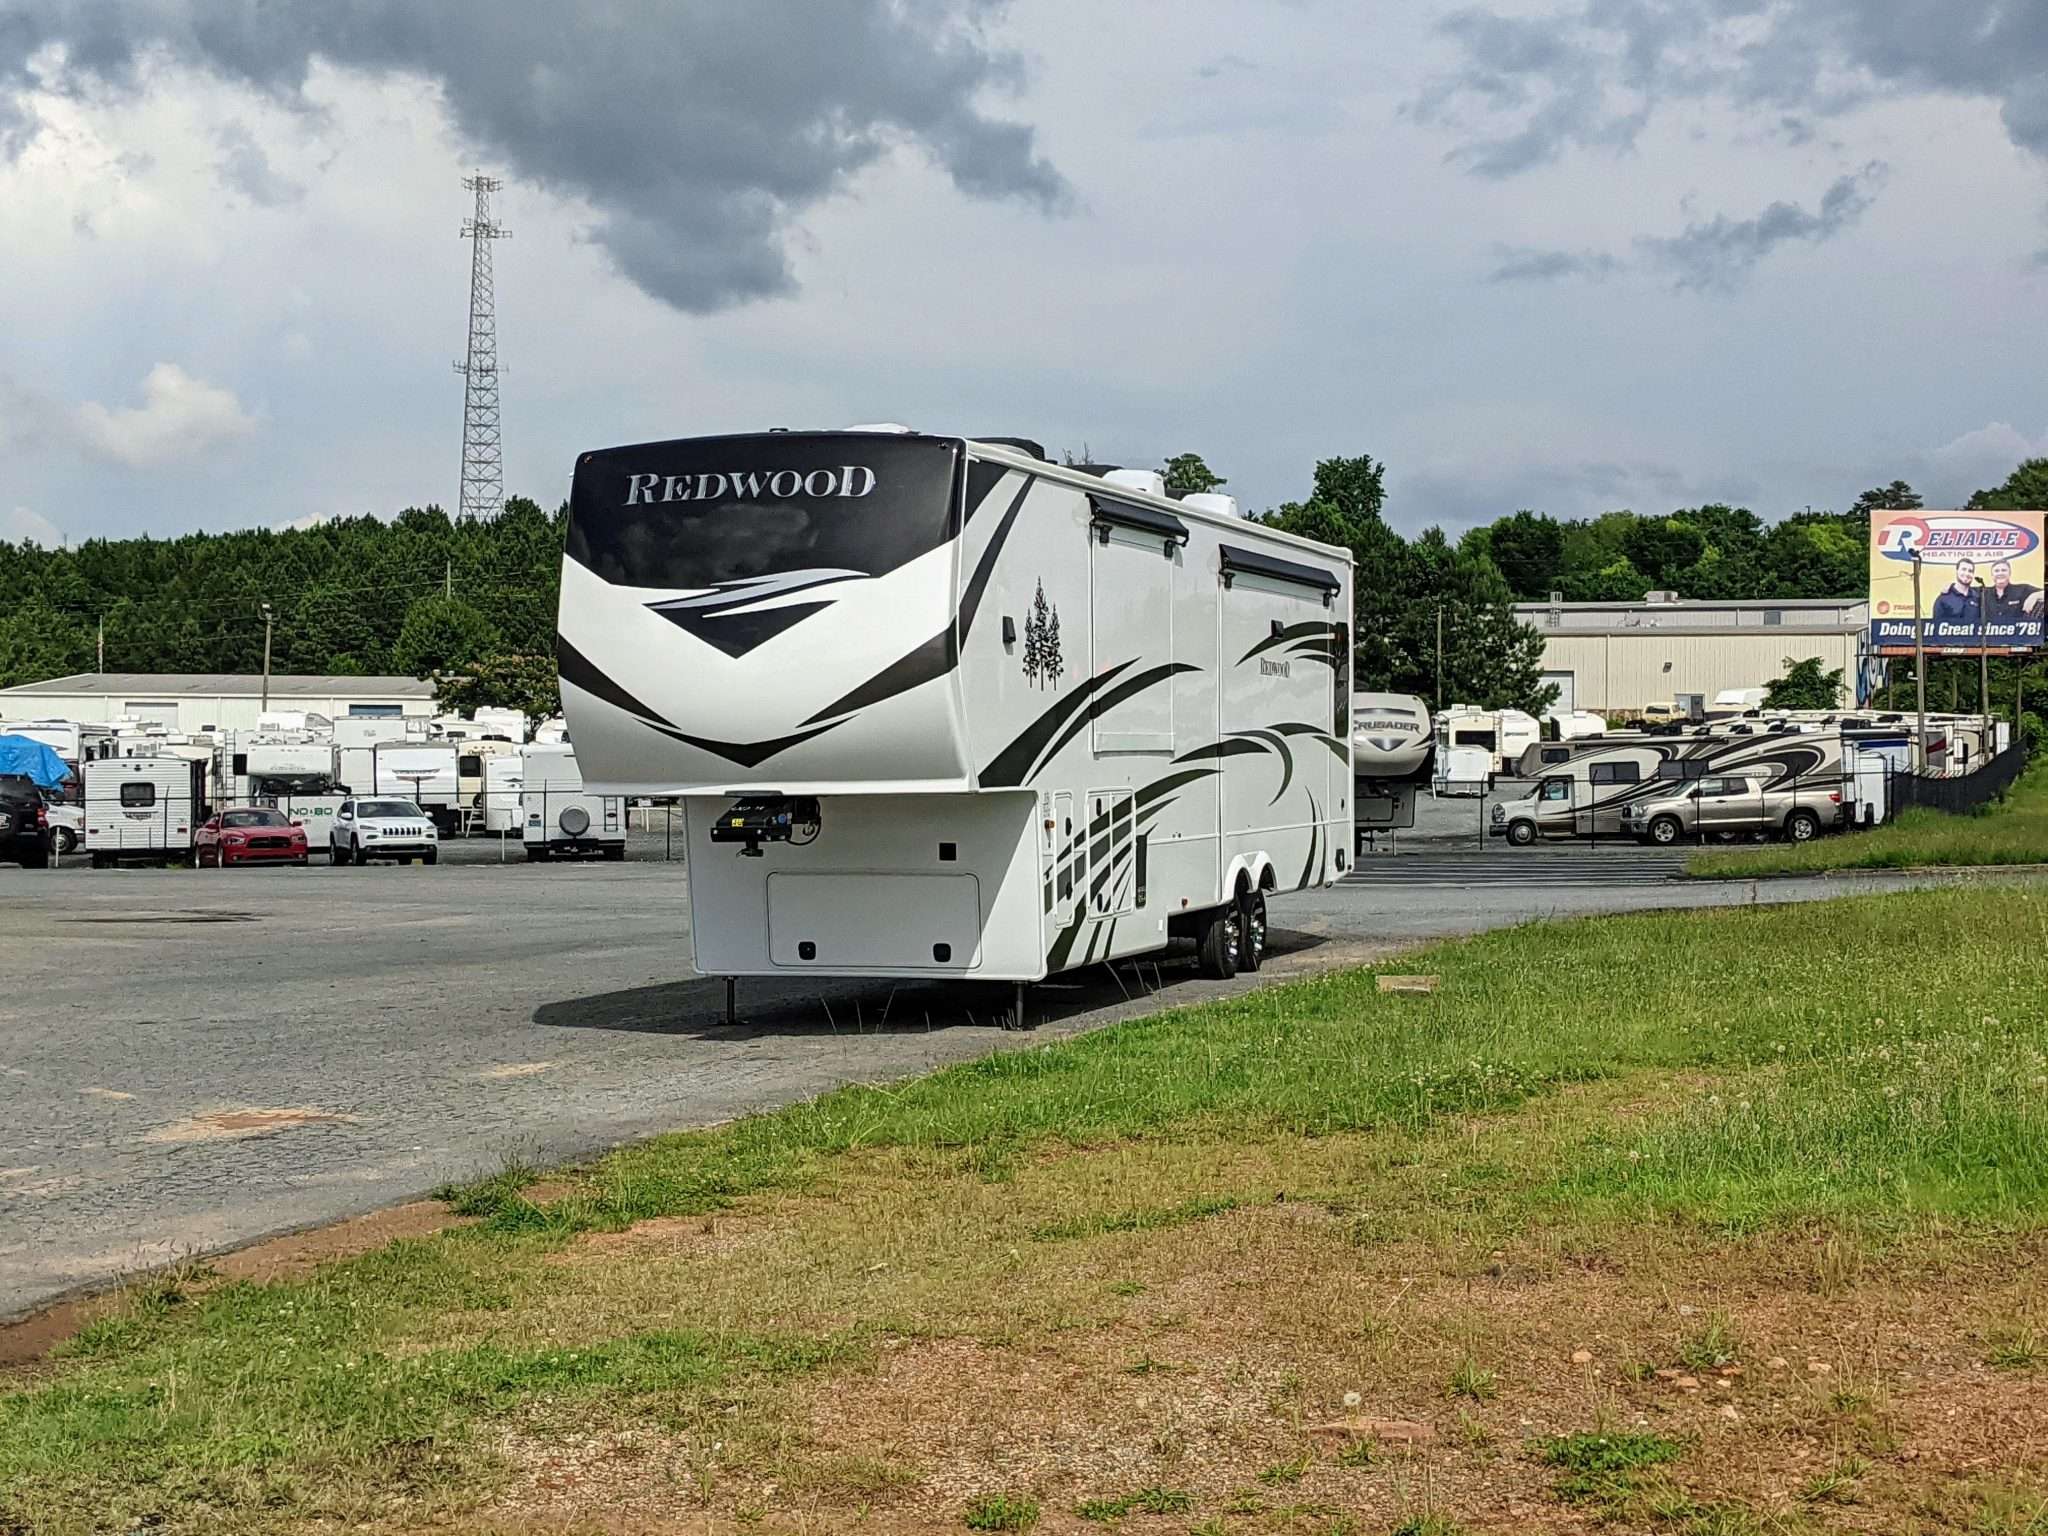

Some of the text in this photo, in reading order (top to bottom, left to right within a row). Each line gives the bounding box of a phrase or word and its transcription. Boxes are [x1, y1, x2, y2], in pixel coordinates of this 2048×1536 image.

[621, 465, 876, 506] REDWOOD
[1880, 524, 2019, 559] RELIABLE
[1938, 621, 1975, 636] Great
[1260, 657, 1290, 678] REDWOOD
